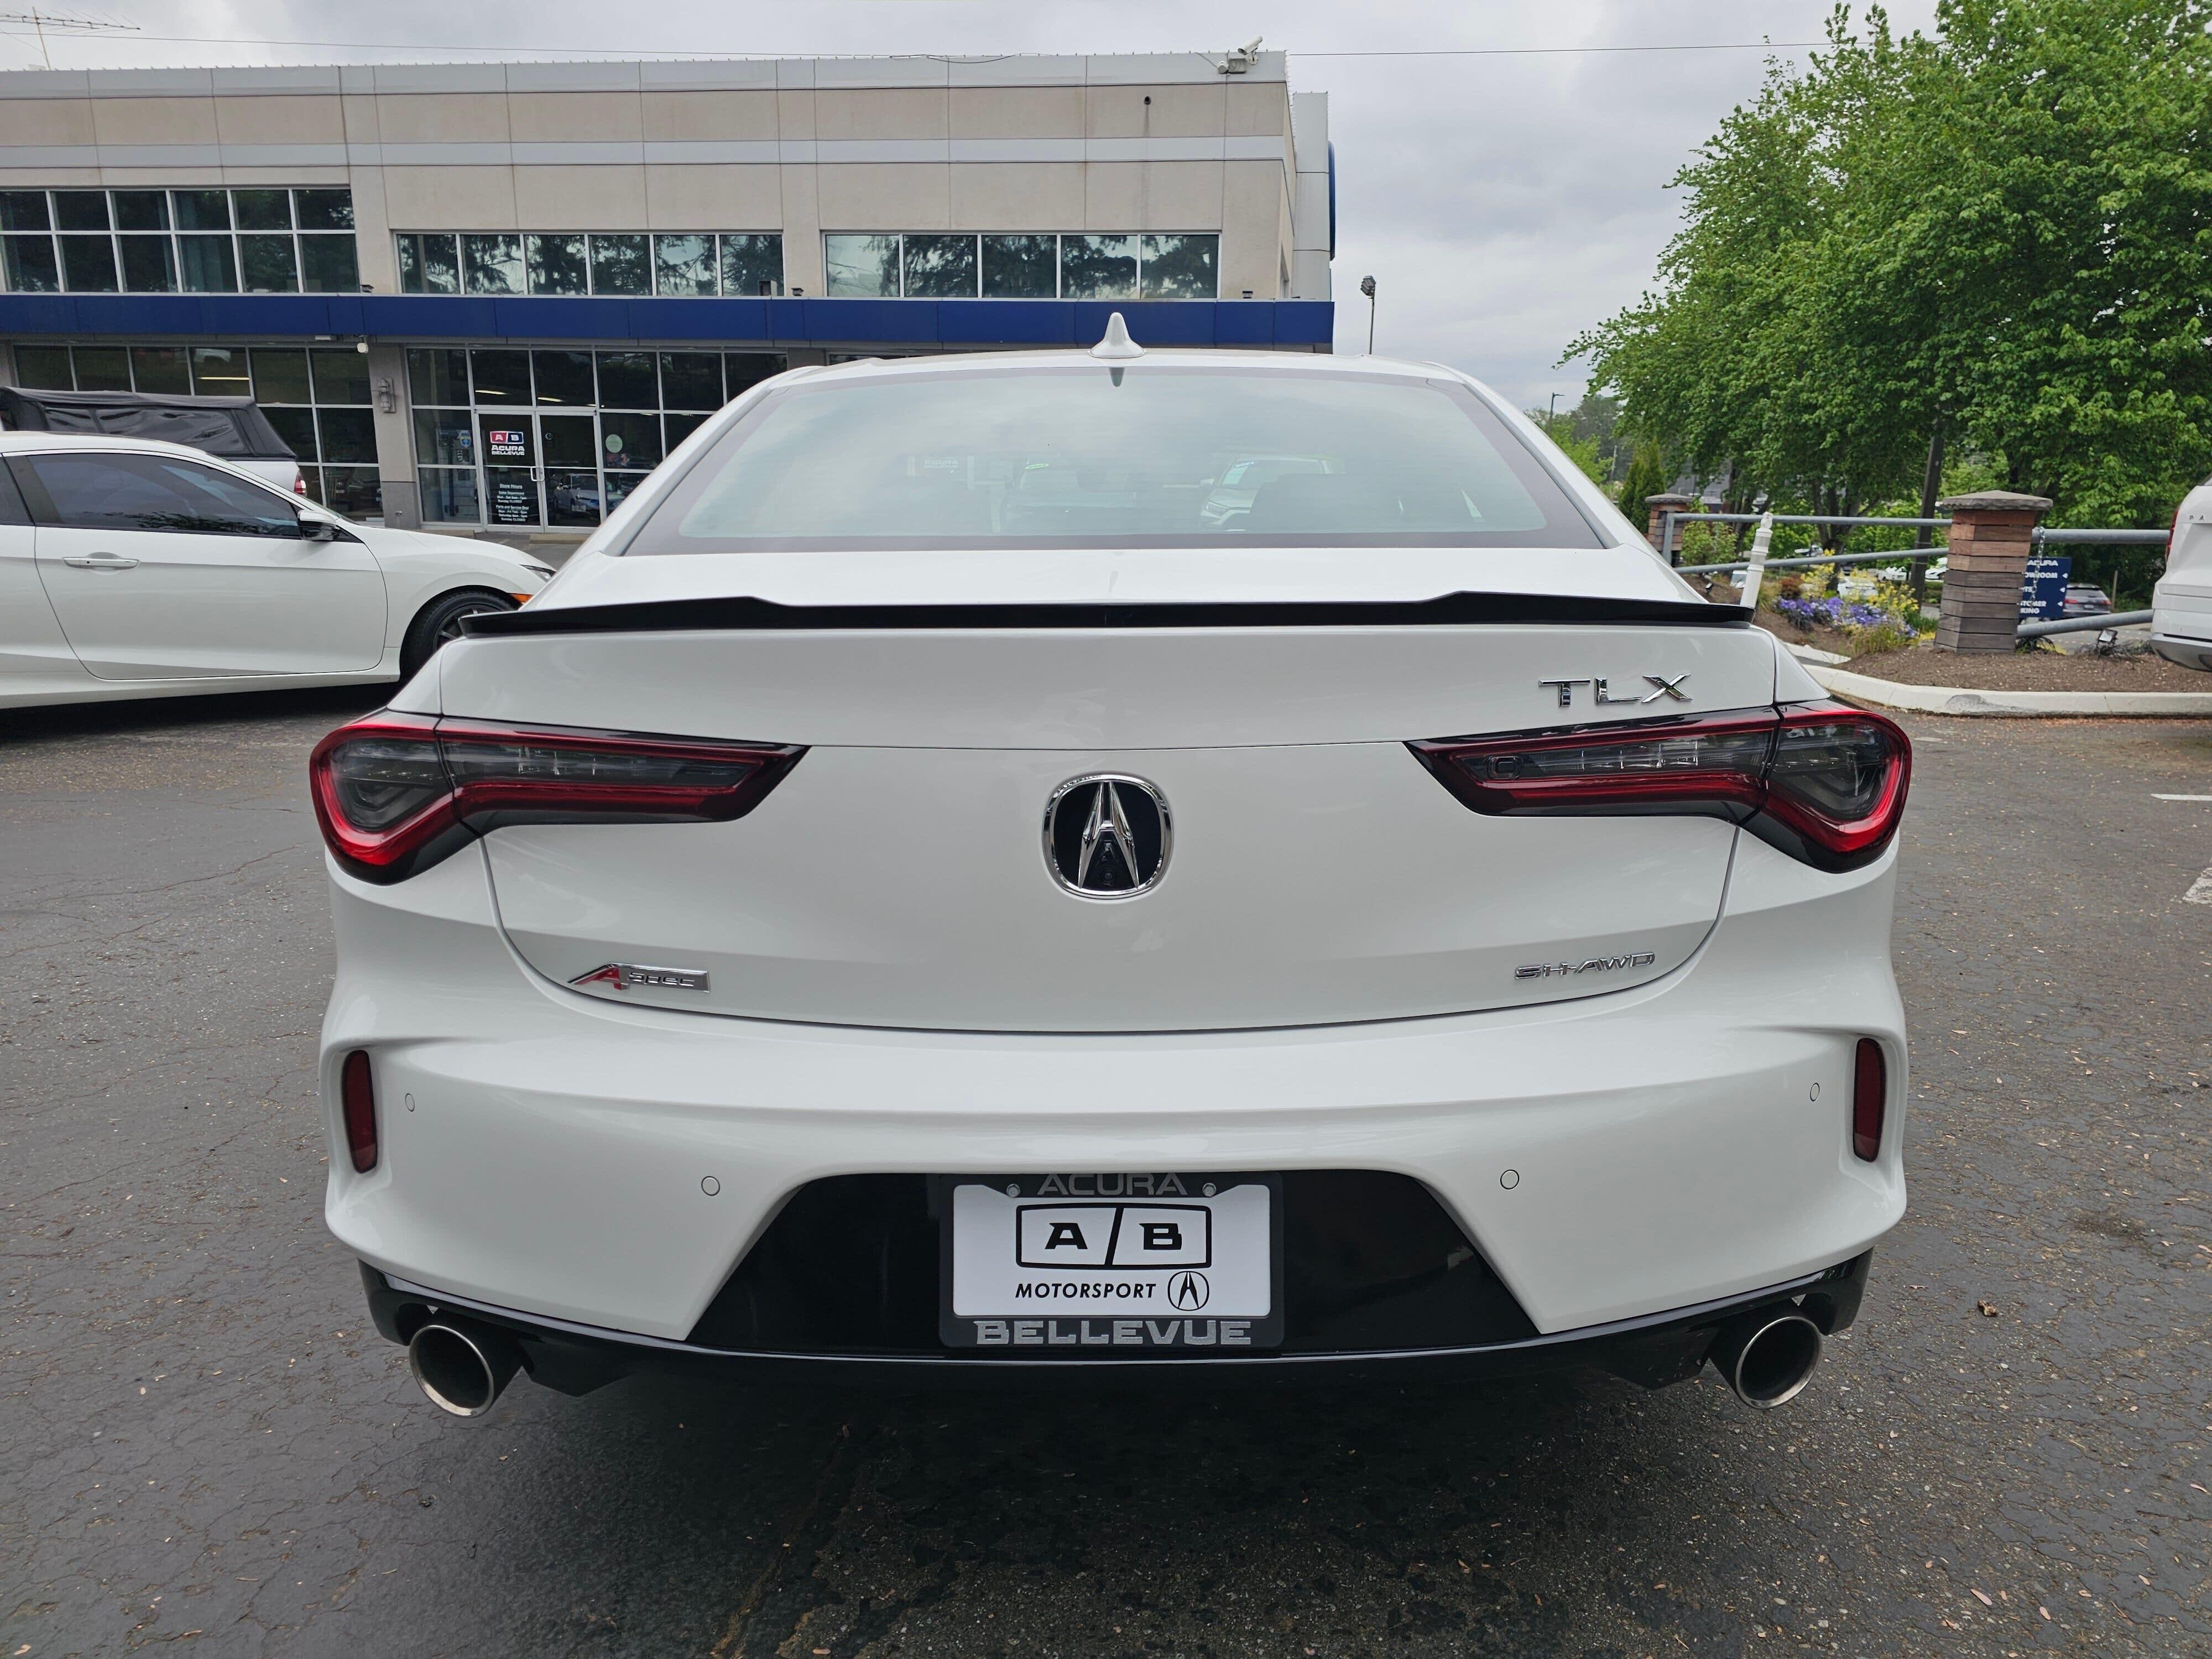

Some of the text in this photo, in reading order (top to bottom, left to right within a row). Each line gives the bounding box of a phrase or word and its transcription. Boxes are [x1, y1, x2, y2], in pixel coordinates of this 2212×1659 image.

[1538, 673, 1693, 708] TLX
[1514, 951, 1656, 980] SH-AWD
[1037, 1173, 1188, 1195] ACURA
[1045, 1222, 1182, 1250] A B
[1015, 1283, 1157, 1298] MOTORSPORT
[973, 1320, 1251, 1345] BELLEVUE
